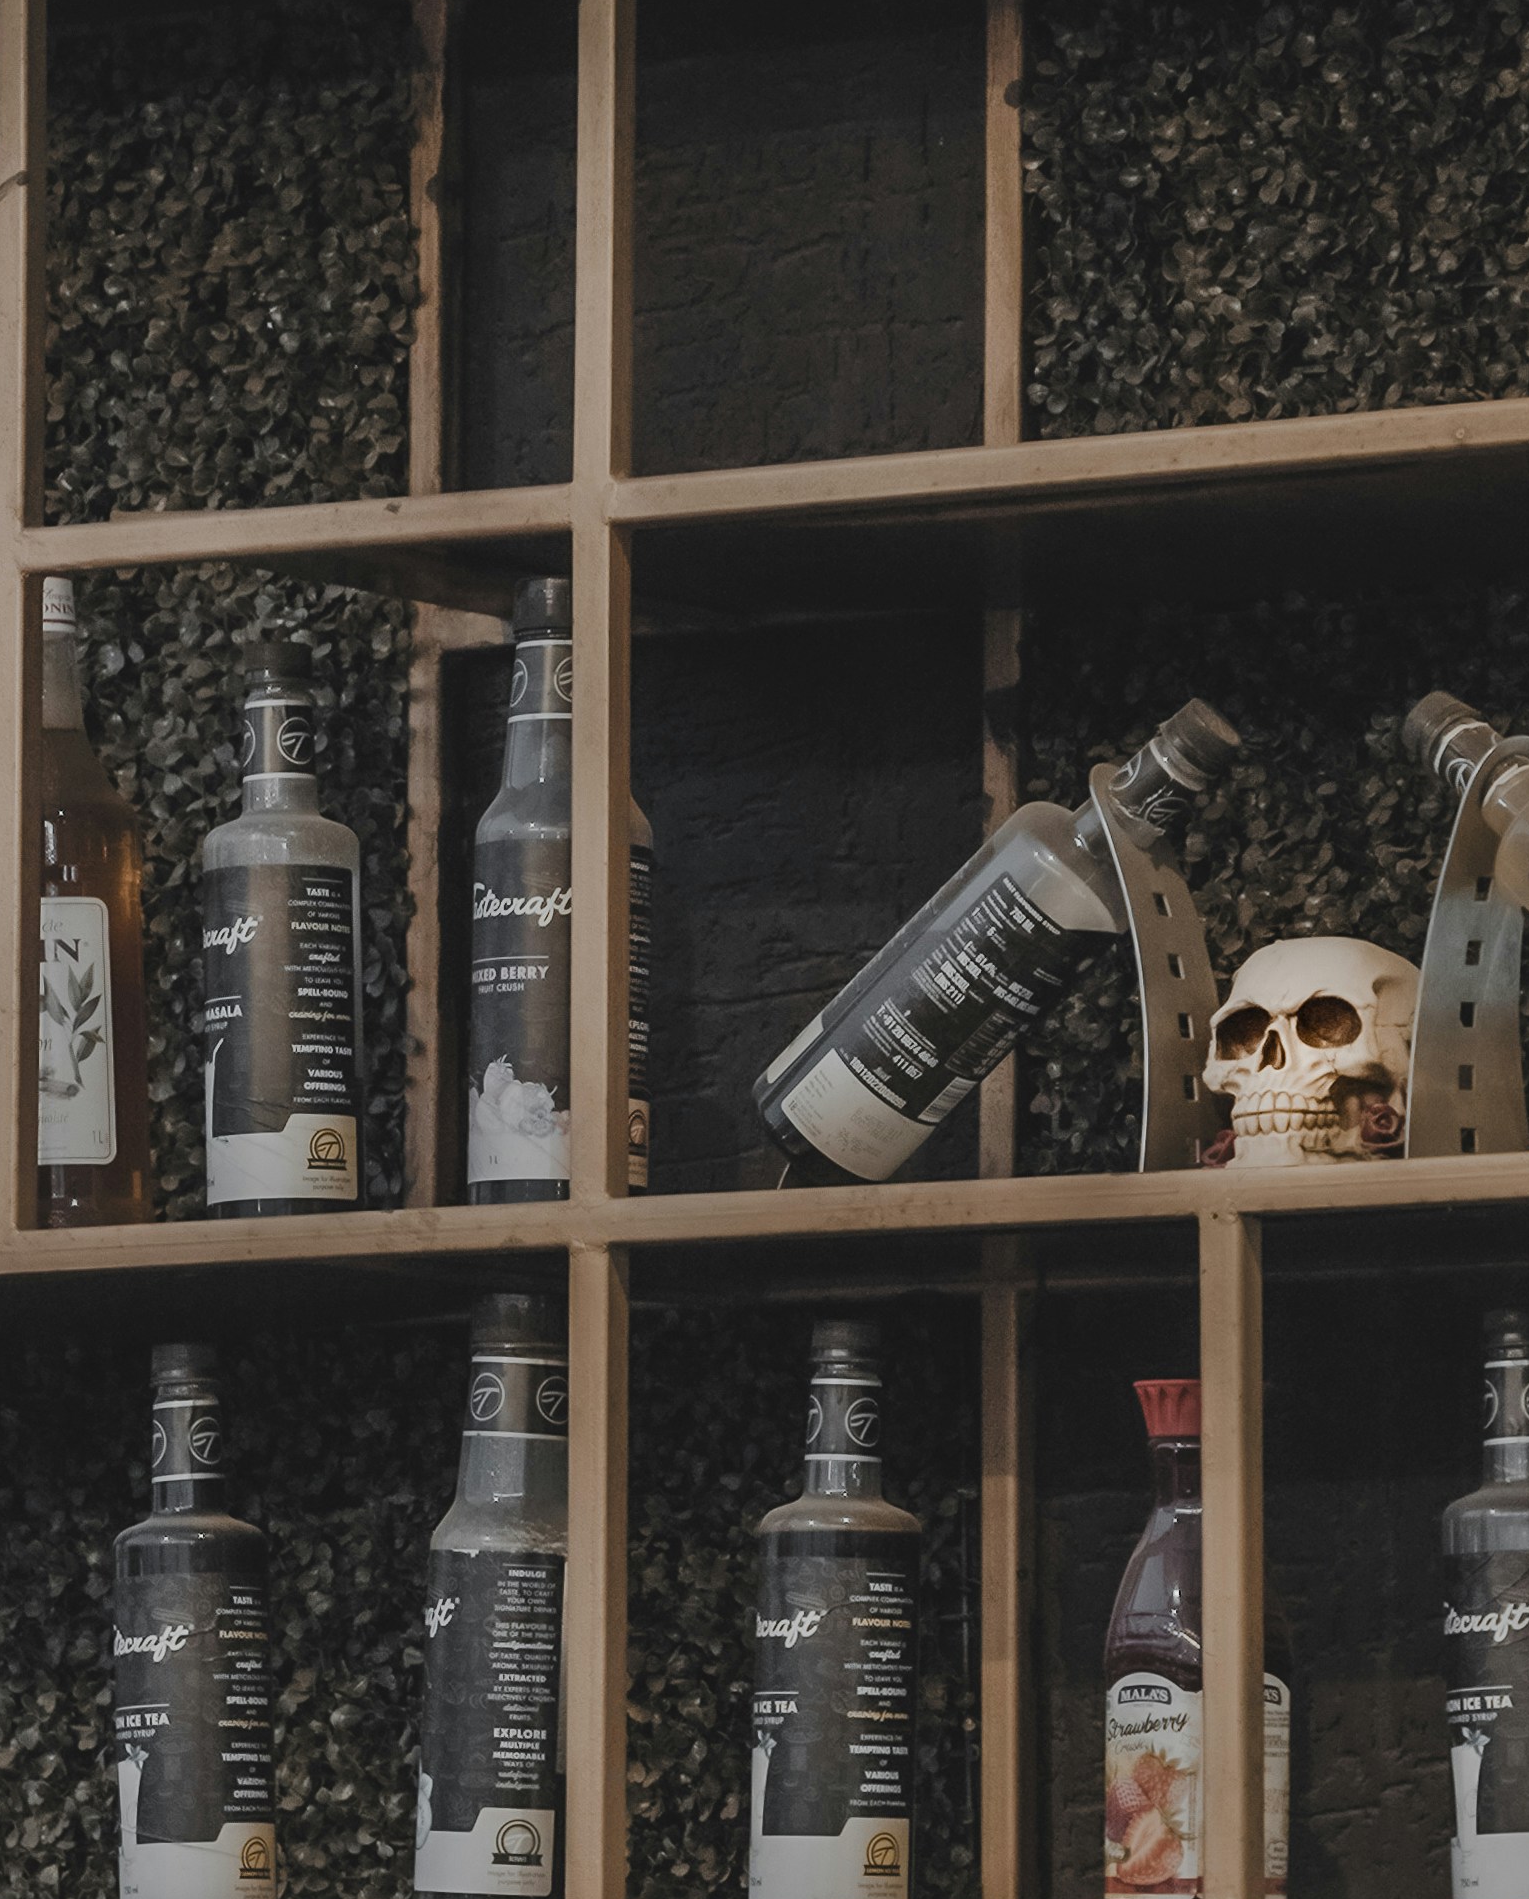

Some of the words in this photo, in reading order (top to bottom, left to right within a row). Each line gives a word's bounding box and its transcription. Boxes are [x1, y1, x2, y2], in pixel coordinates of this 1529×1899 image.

[291, 921, 330, 931] FLAVOUR
[498, 966, 550, 981] BERRY
[297, 987, 349, 999] SPELL-BOUND
[496, 983, 525, 993] CRUSH
[291, 1044, 334, 1055] TEMPTING
[307, 1067, 343, 1079] VARIOUS
[303, 1081, 347, 1092] OFFERINGS
[508, 1569, 547, 1579] INDULGE
[521, 1581, 545, 1589] WORLD
[869, 1582, 893, 1593] TASTE
[507, 1597, 526, 1605] YOUR
[511, 1622, 547, 1631] FLAVOUR
[852, 1617, 891, 1627] FLAVOUR
[219, 1630, 254, 1639] FLAVOUR
[491, 1630, 508, 1638] ONE
[509, 1630, 519, 1638] OF
[488, 1653, 498, 1661] OF
[498, 1673, 548, 1683] EXTRACTED
[503, 1686, 530, 1694] EXPERTS
[1120, 1688, 1170, 1702] MALA'S
[487, 1693, 527, 1703] SELECTIVELY
[1462, 1696, 1482, 1711] ICE
[1483, 1695, 1514, 1710] TEA
[774, 1700, 799, 1714] TEA
[125, 1712, 142, 1727] ICE
[144, 1712, 170, 1726] TEA
[1472, 1712, 1498, 1723] SYRUP
[1107, 1712, 1190, 1742] Strawberry
[133, 1727, 156, 1738] SYRUP
[493, 1727, 547, 1741] EXPLORE
[499, 1740, 540, 1750] MULTIPLE
[849, 1744, 891, 1755] TEMPTING
[221, 1752, 257, 1762] TEMPTING
[492, 1750, 546, 1761] MEMORABLE
[503, 1760, 524, 1768] WAYS
[864, 1770, 899, 1780] VARIOUS
[860, 1784, 901, 1794] OFFERINGS
